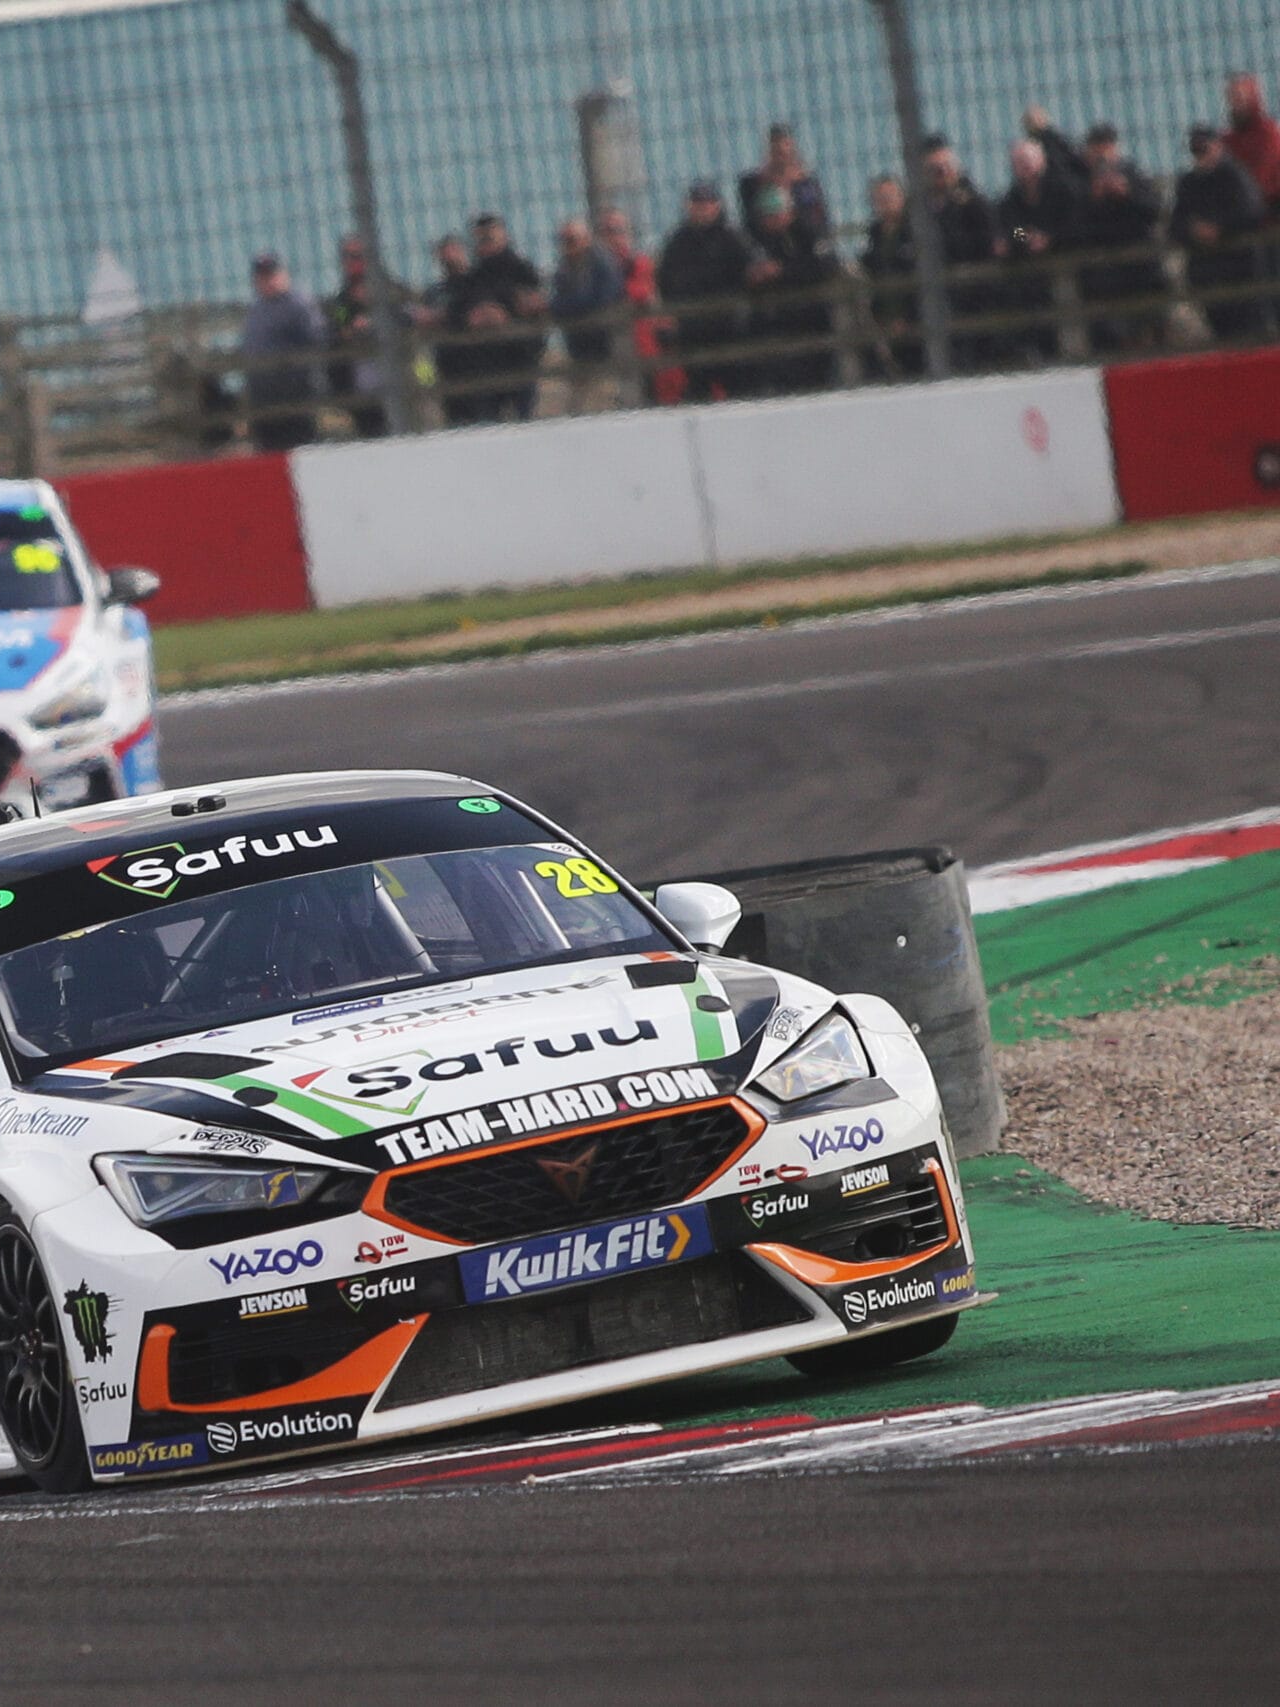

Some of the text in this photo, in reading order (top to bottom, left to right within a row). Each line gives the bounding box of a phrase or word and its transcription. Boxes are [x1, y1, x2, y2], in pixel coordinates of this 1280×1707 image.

[127, 825, 338, 888] Safuu
[534, 857, 619, 898] 28
[348, 1020, 658, 1098] Safuu
[375, 1068, 719, 1167] TEAM-HARD.COM
[799, 1118, 884, 1161] YAZOO
[738, 1164, 761, 1177] TOW
[840, 1164, 889, 1193] JEWSON
[751, 1194, 809, 1220] Safuu
[381, 1234, 406, 1248] TOW
[210, 1240, 323, 1285] YAZOO
[239, 1289, 308, 1317] JEWSON
[349, 1277, 416, 1302] Safuu
[867, 1278, 936, 1310] Evolution
[79, 1381, 127, 1404] Safuu
[239, 1412, 353, 1443] Evolution
